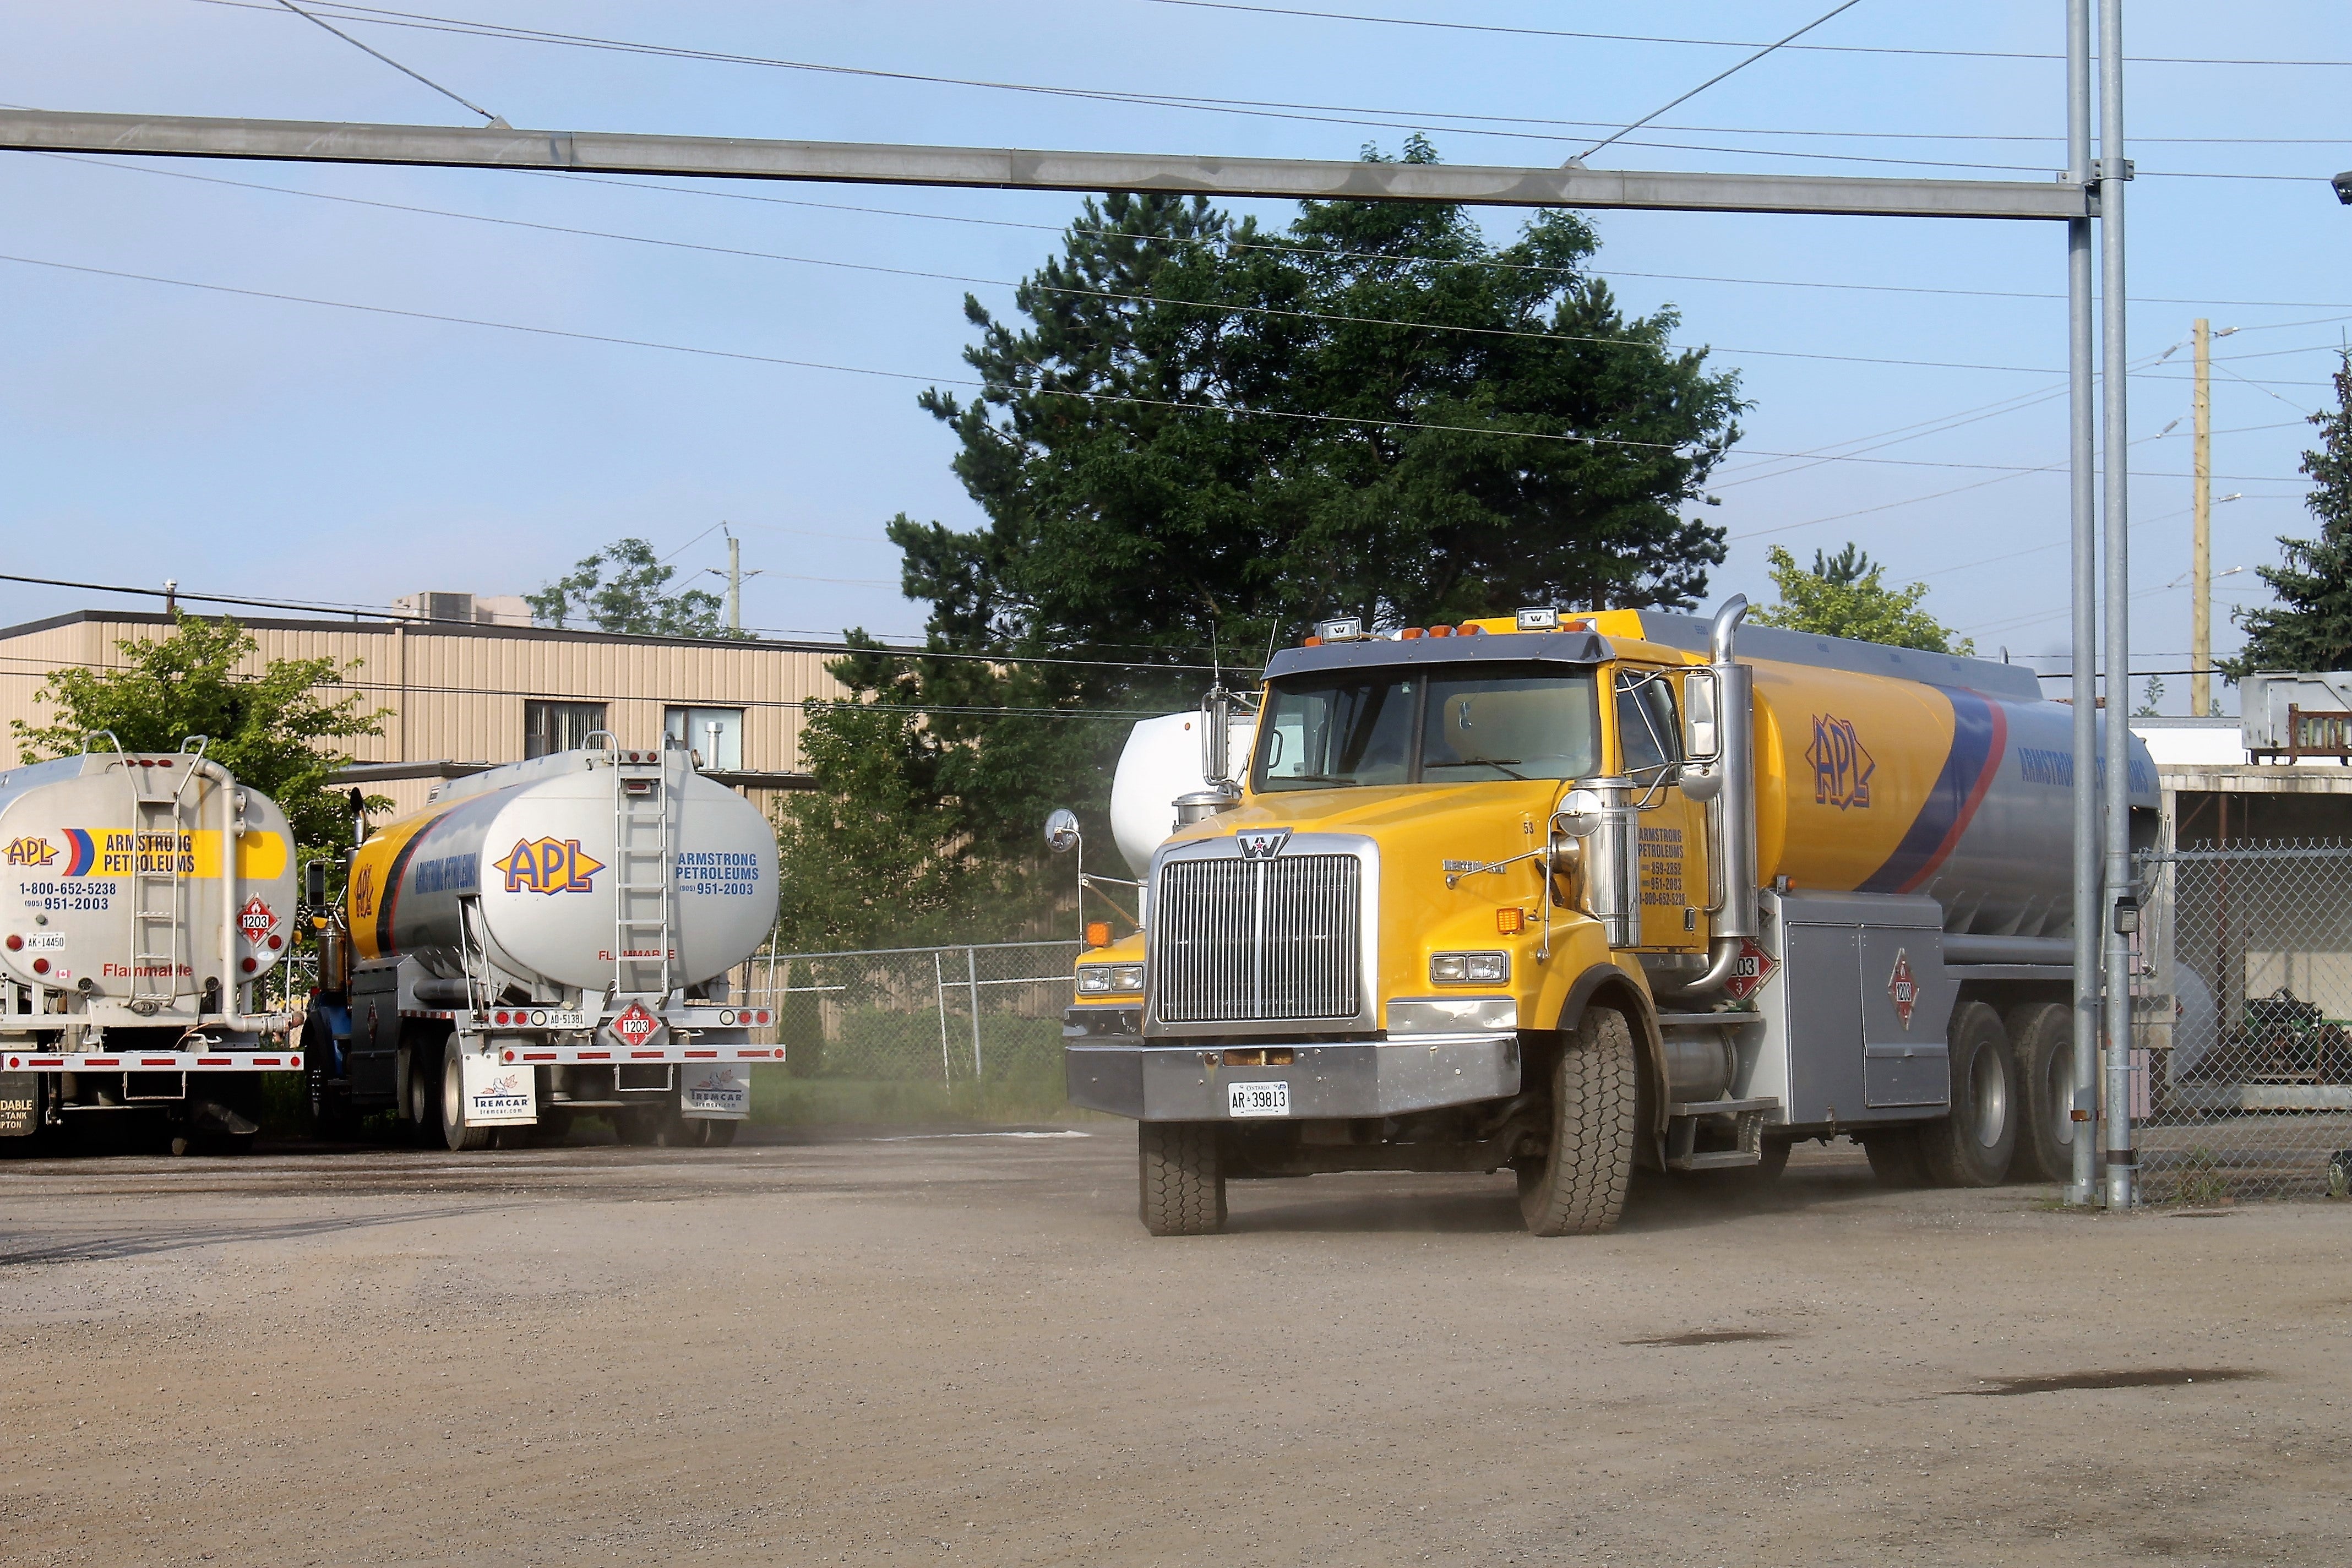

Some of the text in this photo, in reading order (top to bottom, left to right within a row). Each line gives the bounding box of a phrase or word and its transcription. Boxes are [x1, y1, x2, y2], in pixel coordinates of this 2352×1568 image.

[1815, 716, 1869, 805] APL
[1523, 822, 1534, 834] 53
[1638, 827, 1682, 842] ARMSTRONG
[8, 837, 52, 865] APL
[1638, 843, 1684, 858] PETROLEUMS
[507, 840, 590, 890] APL
[678, 853, 757, 866] ARMSTRONG
[676, 867, 759, 880] PETROLEUMS
[20, 882, 116, 895] 1-800-652-5238
[697, 883, 754, 895] 951-2003
[45, 897, 109, 910] 951-2003
[244, 916, 267, 928] 1203
[252, 929, 259, 940] 3
[598, 950, 675, 960] FLMMABE
[625, 1021, 648, 1033] 1203
[0, 1099, 32, 1110] DABLE
[473, 1095, 528, 1108] TREMCAR
[1251, 1091, 1286, 1108] 39813
[0, 1120, 22, 1129] PTON
